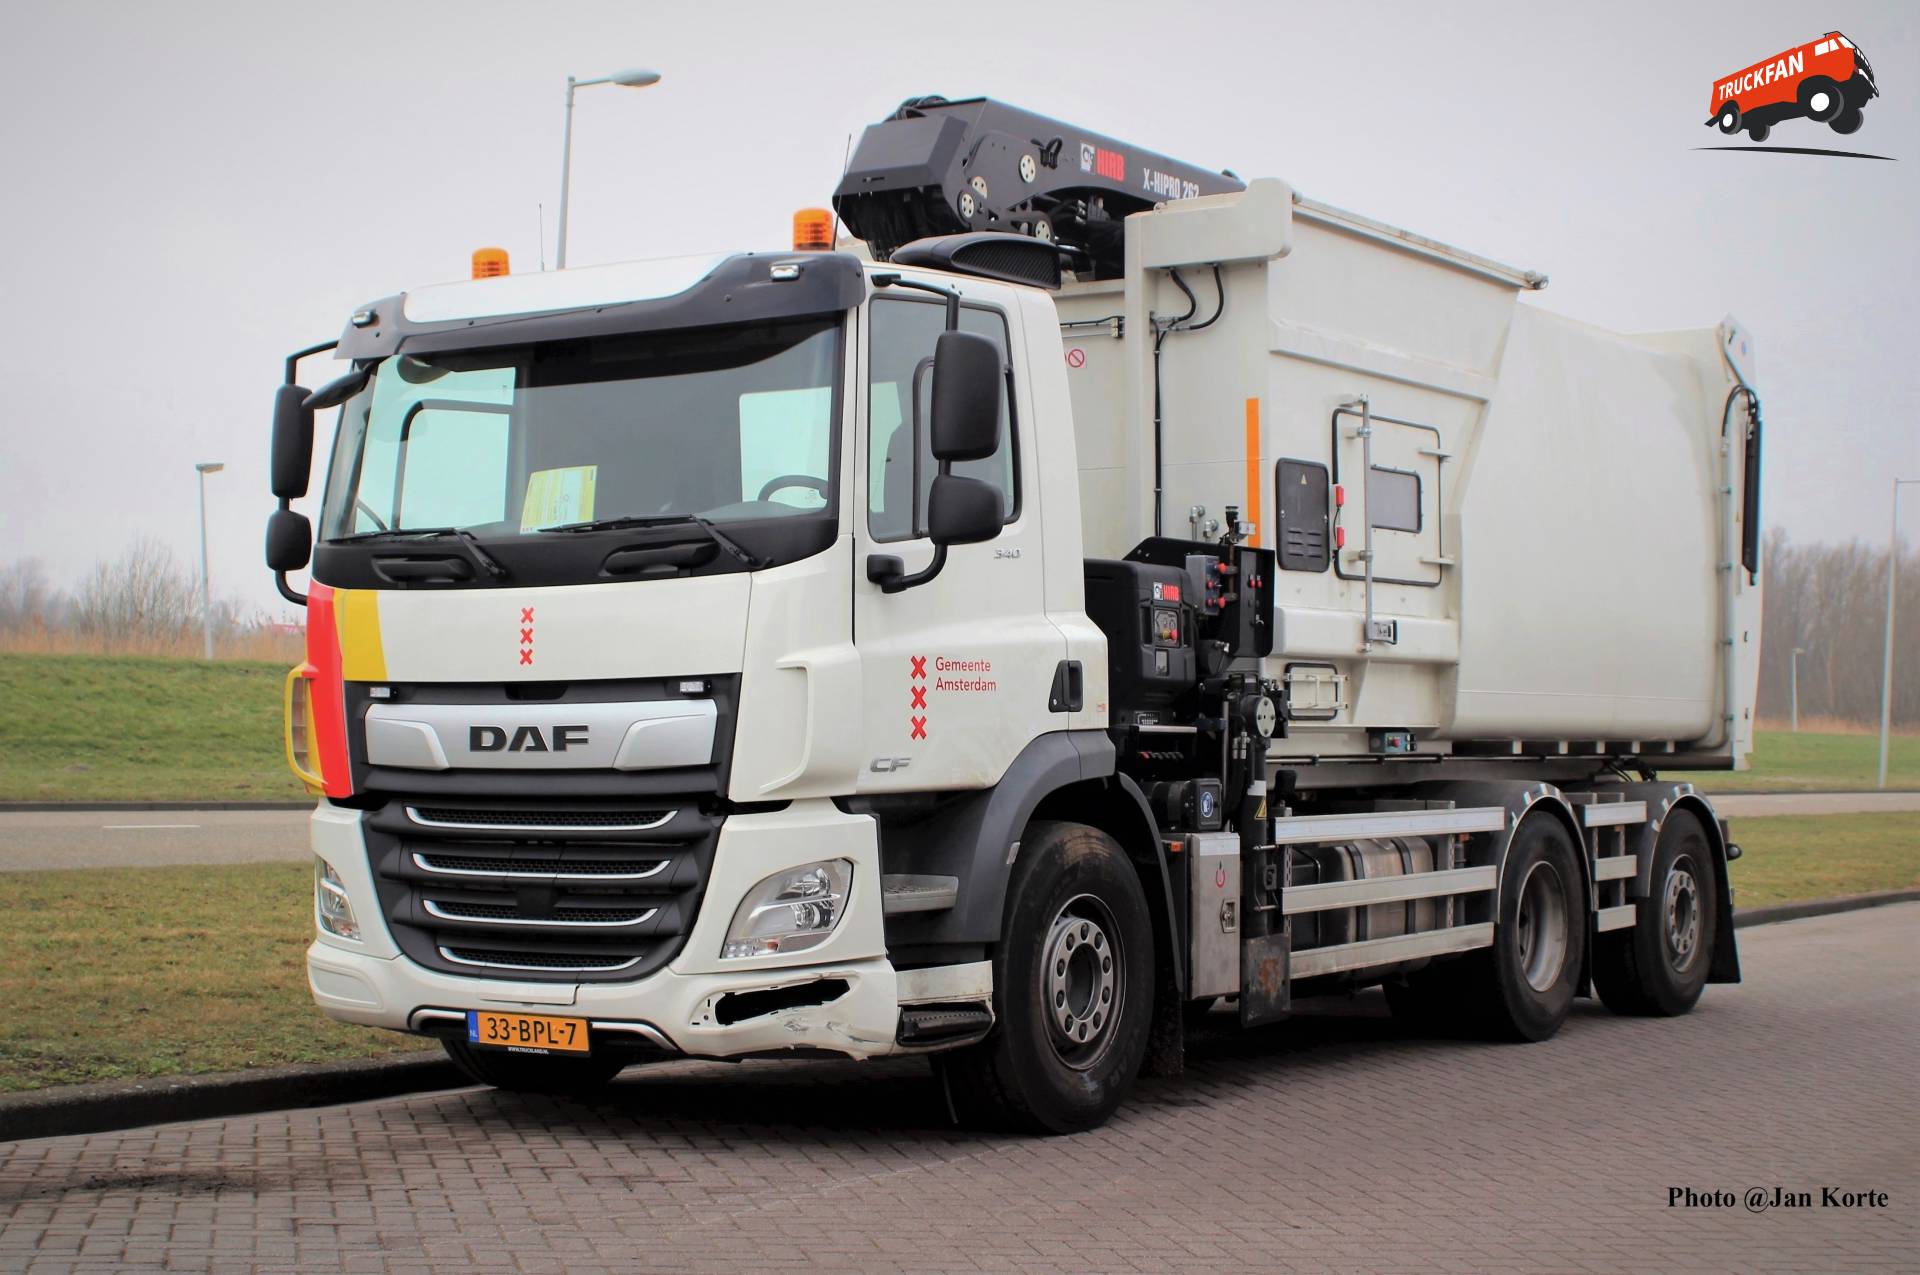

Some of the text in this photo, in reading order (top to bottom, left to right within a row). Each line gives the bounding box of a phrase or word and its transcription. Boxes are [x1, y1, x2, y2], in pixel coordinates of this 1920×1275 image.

[1143, 167, 1181, 199] X-HIPRO
[935, 657, 991, 672] Gemeente
[935, 677, 997, 692] Amsterdam
[469, 725, 589, 752] DAF
[870, 757, 912, 773] CF
[487, 1017, 577, 1045] 33-BPL-7
